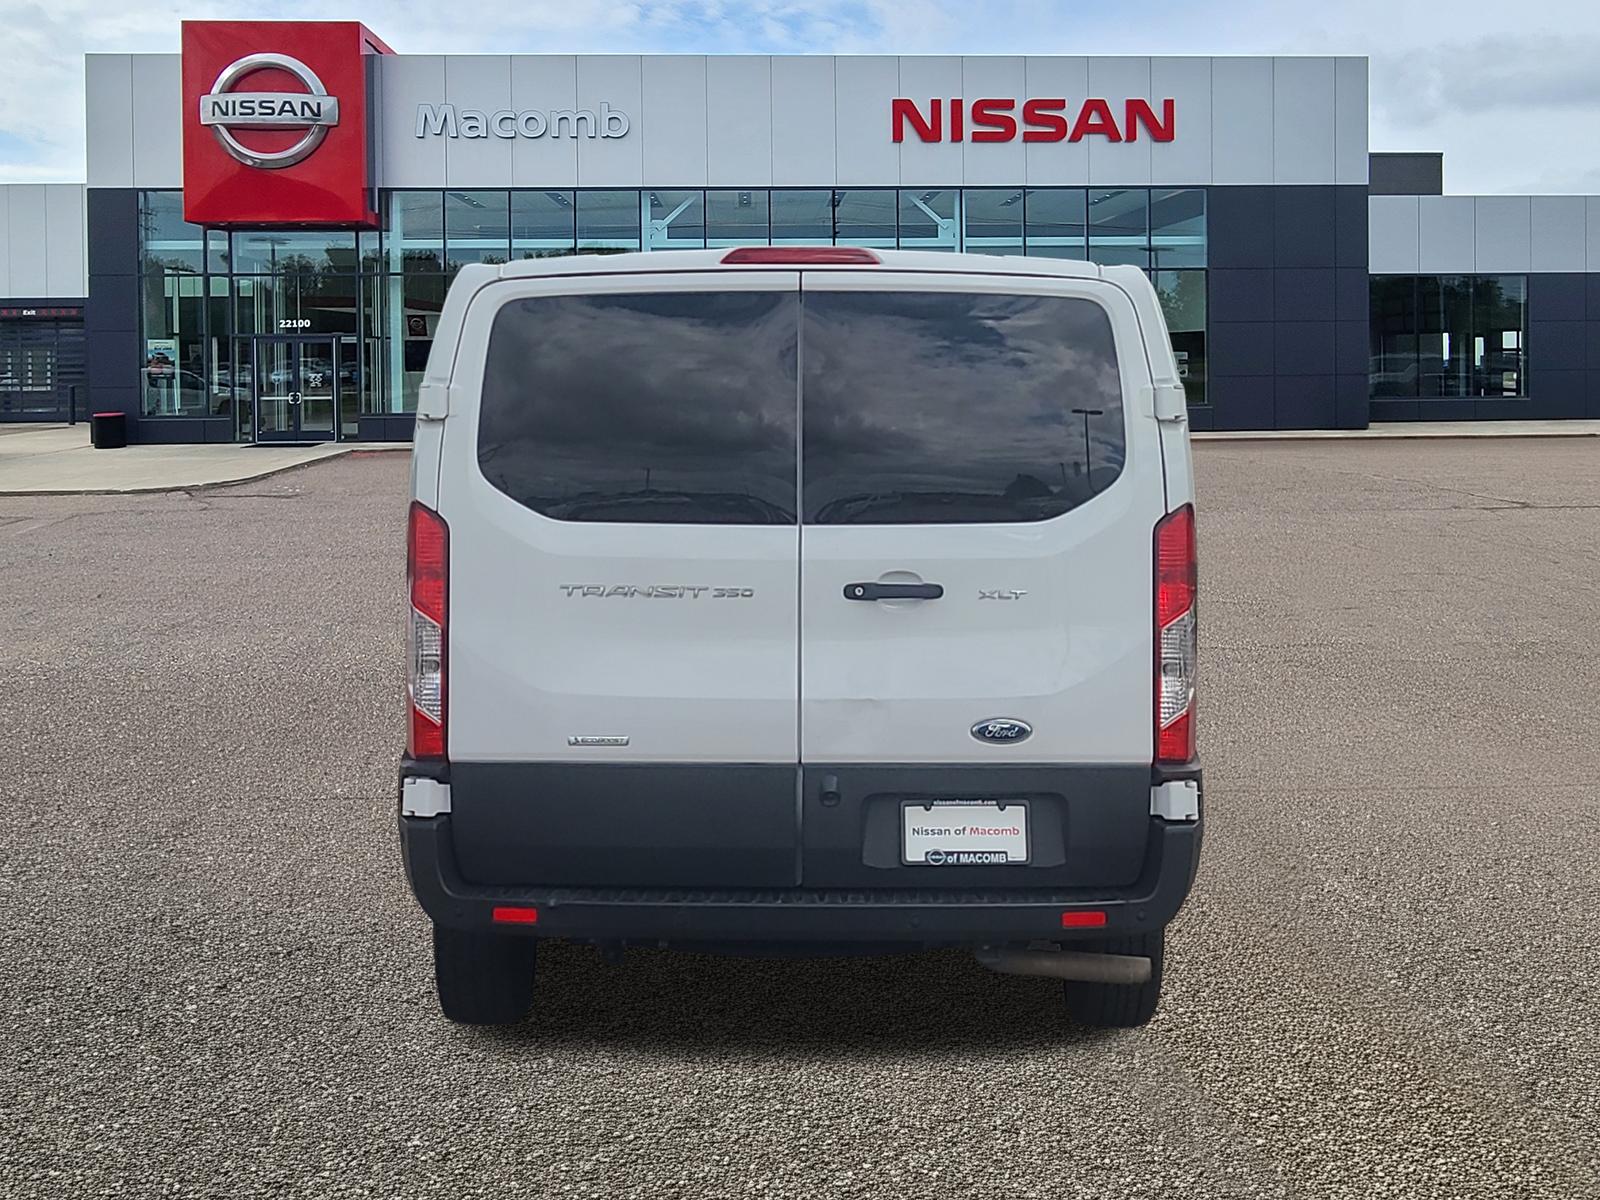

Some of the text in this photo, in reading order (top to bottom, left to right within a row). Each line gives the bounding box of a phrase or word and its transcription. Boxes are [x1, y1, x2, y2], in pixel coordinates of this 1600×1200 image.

[212, 100, 321, 117] NISSAN
[415, 102, 630, 138] Macomb
[893, 98, 1175, 142] NISSAN
[279, 319, 311, 328] 22100
[559, 585, 755, 599] TRANSIT 350
[978, 590, 1029, 600] XLT
[985, 723, 1019, 738] Ford
[912, 826, 1020, 836] Nissan of Macomb
[947, 854, 958, 863] of
[959, 853, 1007, 863] MACOMB
